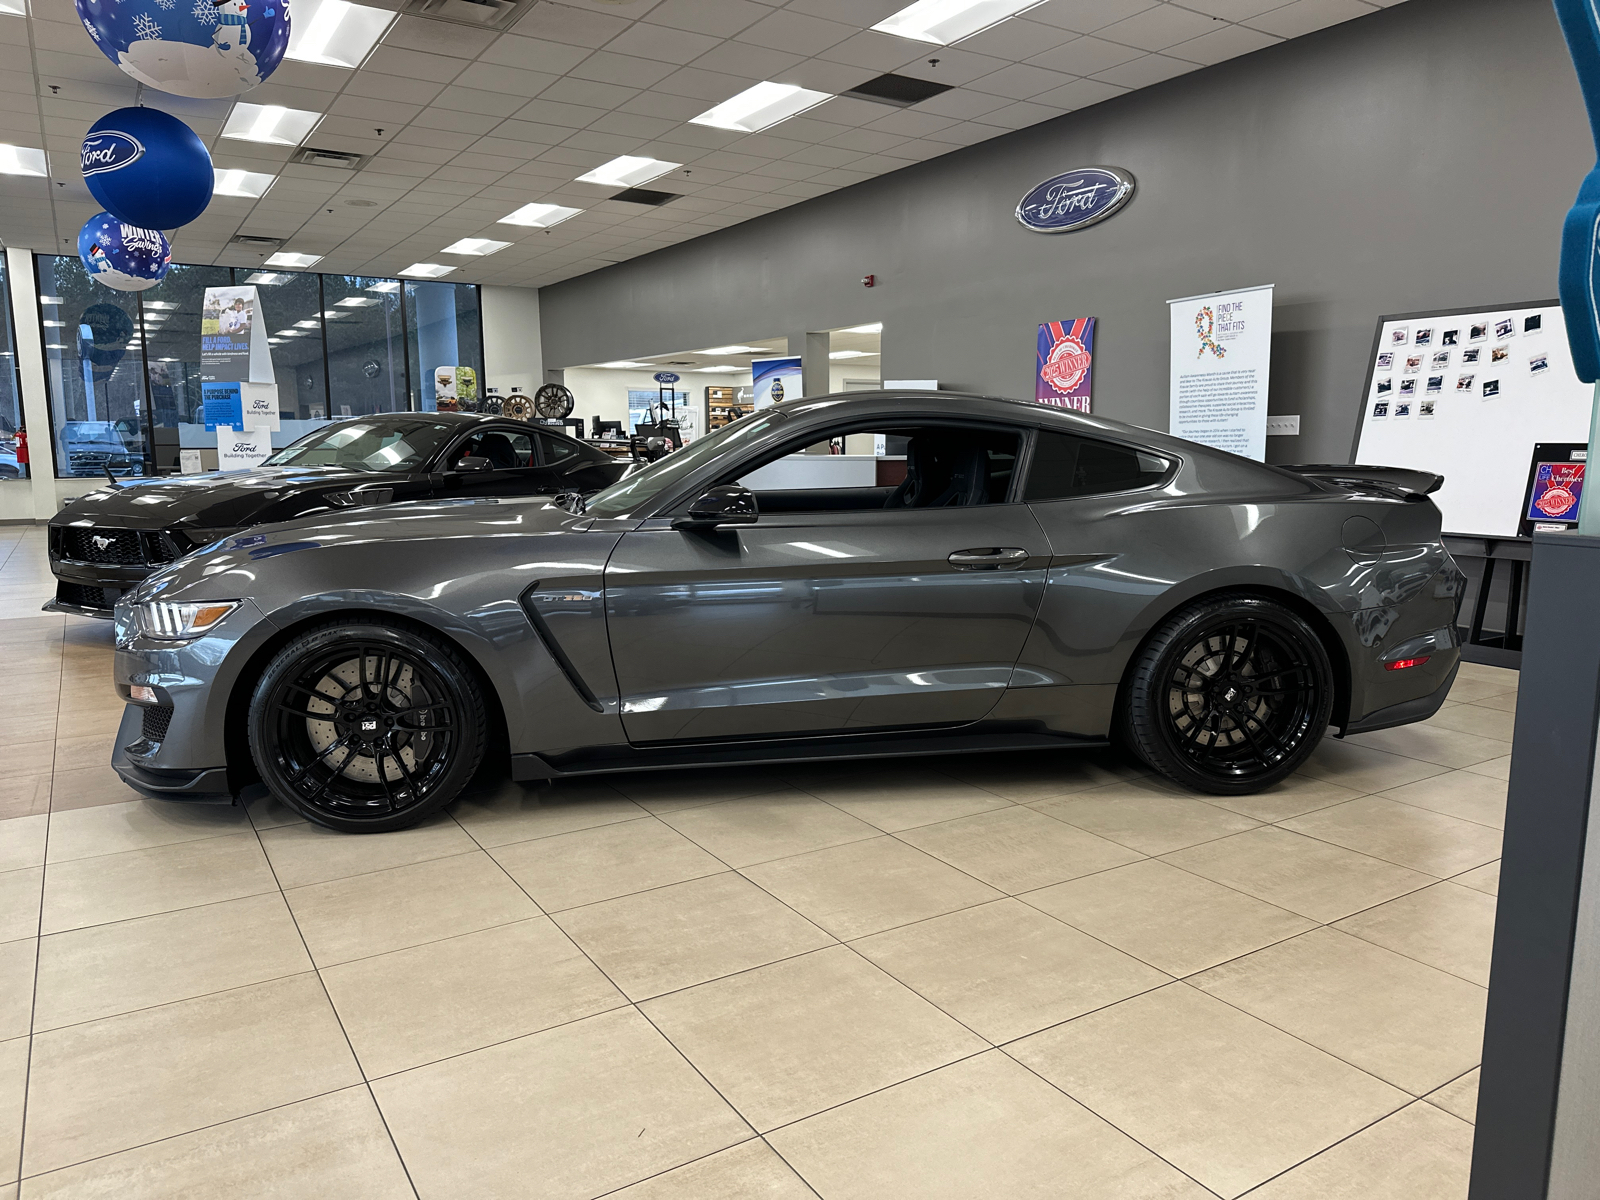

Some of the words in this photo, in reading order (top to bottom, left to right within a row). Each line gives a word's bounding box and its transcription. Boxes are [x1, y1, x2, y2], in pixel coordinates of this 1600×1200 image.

[80, 139, 116, 169] Ford
[1039, 179, 1099, 219] Ford
[120, 223, 163, 245] WINTER
[121, 235, 162, 257] Savings
[1218, 303, 1231, 313] FIND
[1232, 301, 1243, 311] THE
[1218, 312, 1233, 322] PIECE
[1218, 322, 1232, 332] THAT
[1232, 320, 1245, 331] FITS
[202, 336, 213, 344] FILL
[1059, 354, 1087, 372] WINNER
[659, 374, 674, 382] Ford
[252, 399, 269, 410] Ford
[232, 442, 257, 452] Ford
[1540, 465, 1552, 474] CH
[1550, 497, 1573, 506] WINNER
[268, 646, 301, 680] GENERAL
